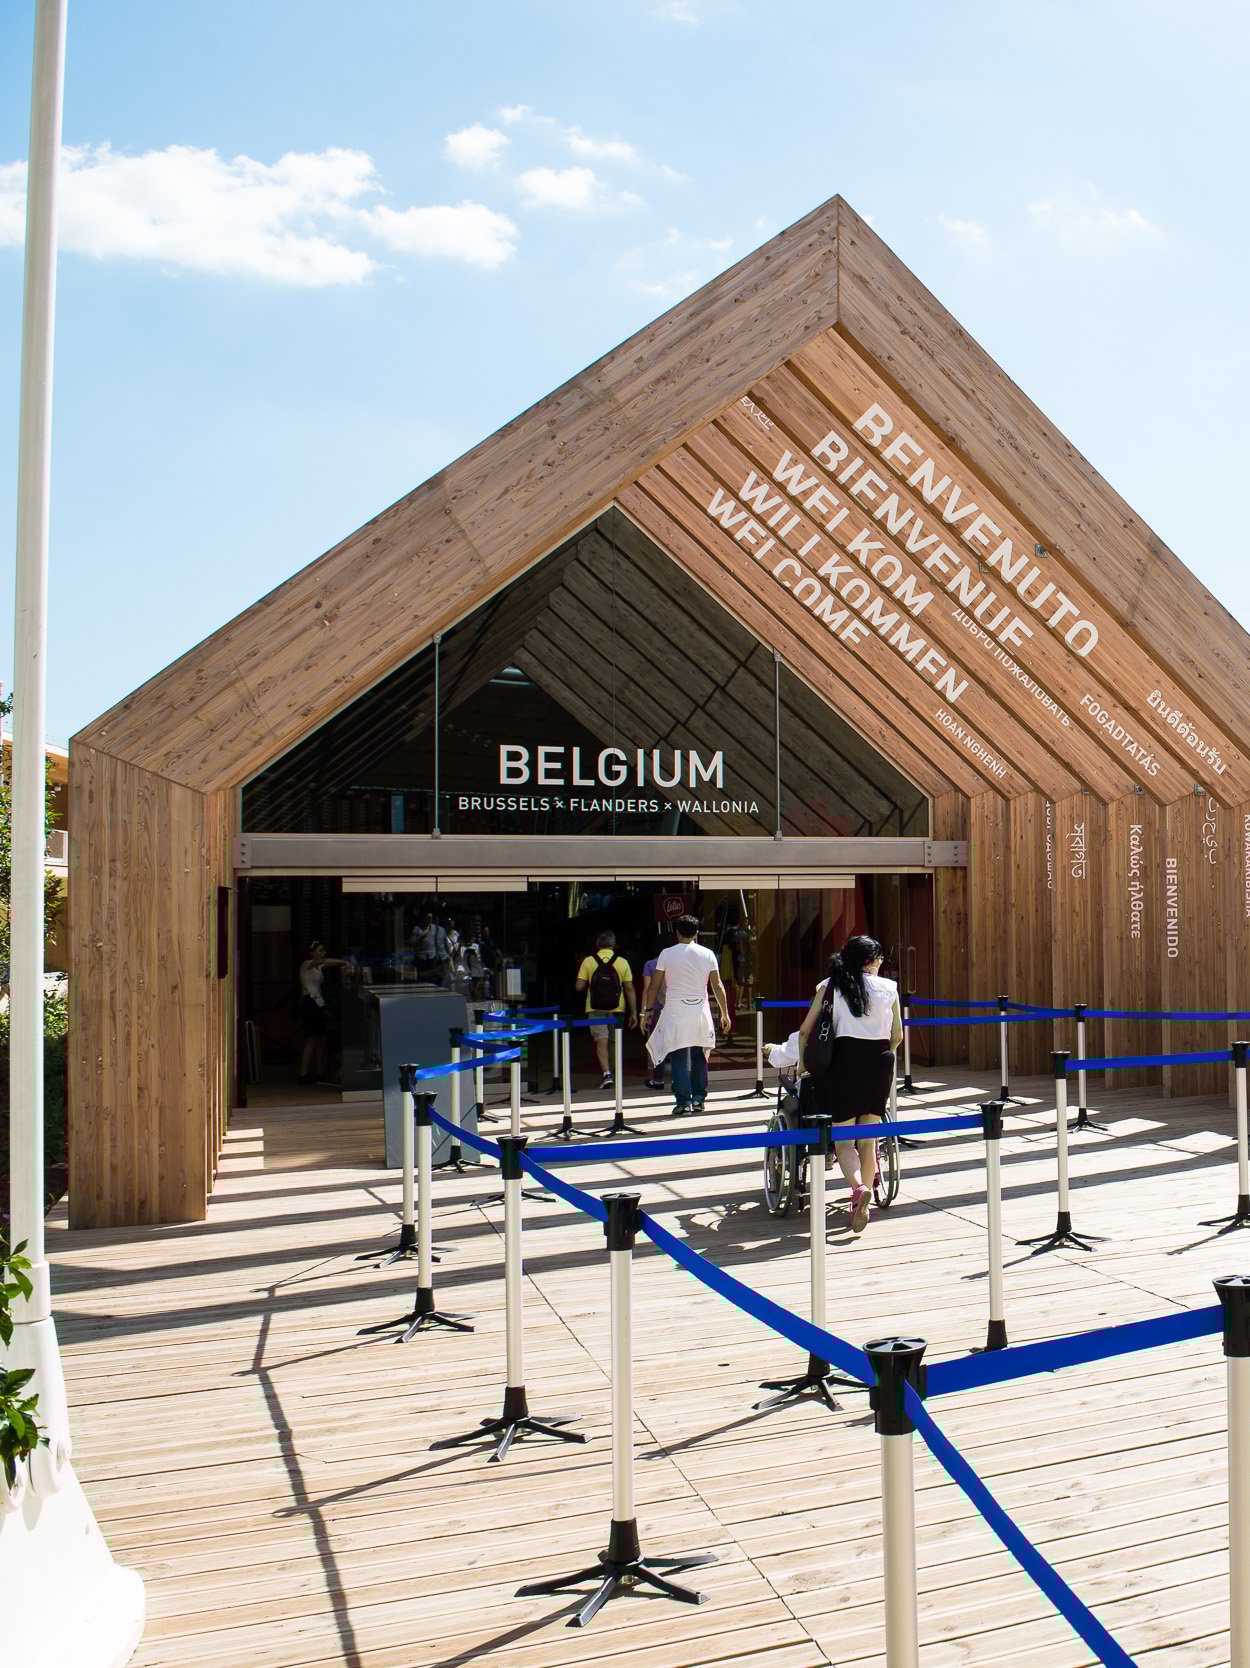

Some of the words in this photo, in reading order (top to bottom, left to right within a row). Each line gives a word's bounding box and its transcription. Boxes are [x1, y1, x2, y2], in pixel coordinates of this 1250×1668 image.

[810, 430, 1033, 655] BIENVENUE
[852, 402, 1099, 657] BENVENUTO
[499, 744, 724, 789] BELGIUM
[934, 708, 965, 740] HOAN
[963, 736, 1007, 778] NGHENH
[1079, 693, 1161, 777] FOGADTATÁS
[458, 797, 550, 811] BRUSSELS
[570, 798, 659, 812] FLANDERS
[677, 800, 760, 813] WALLONIA
[1165, 857, 1179, 959] BIENVENIDO
